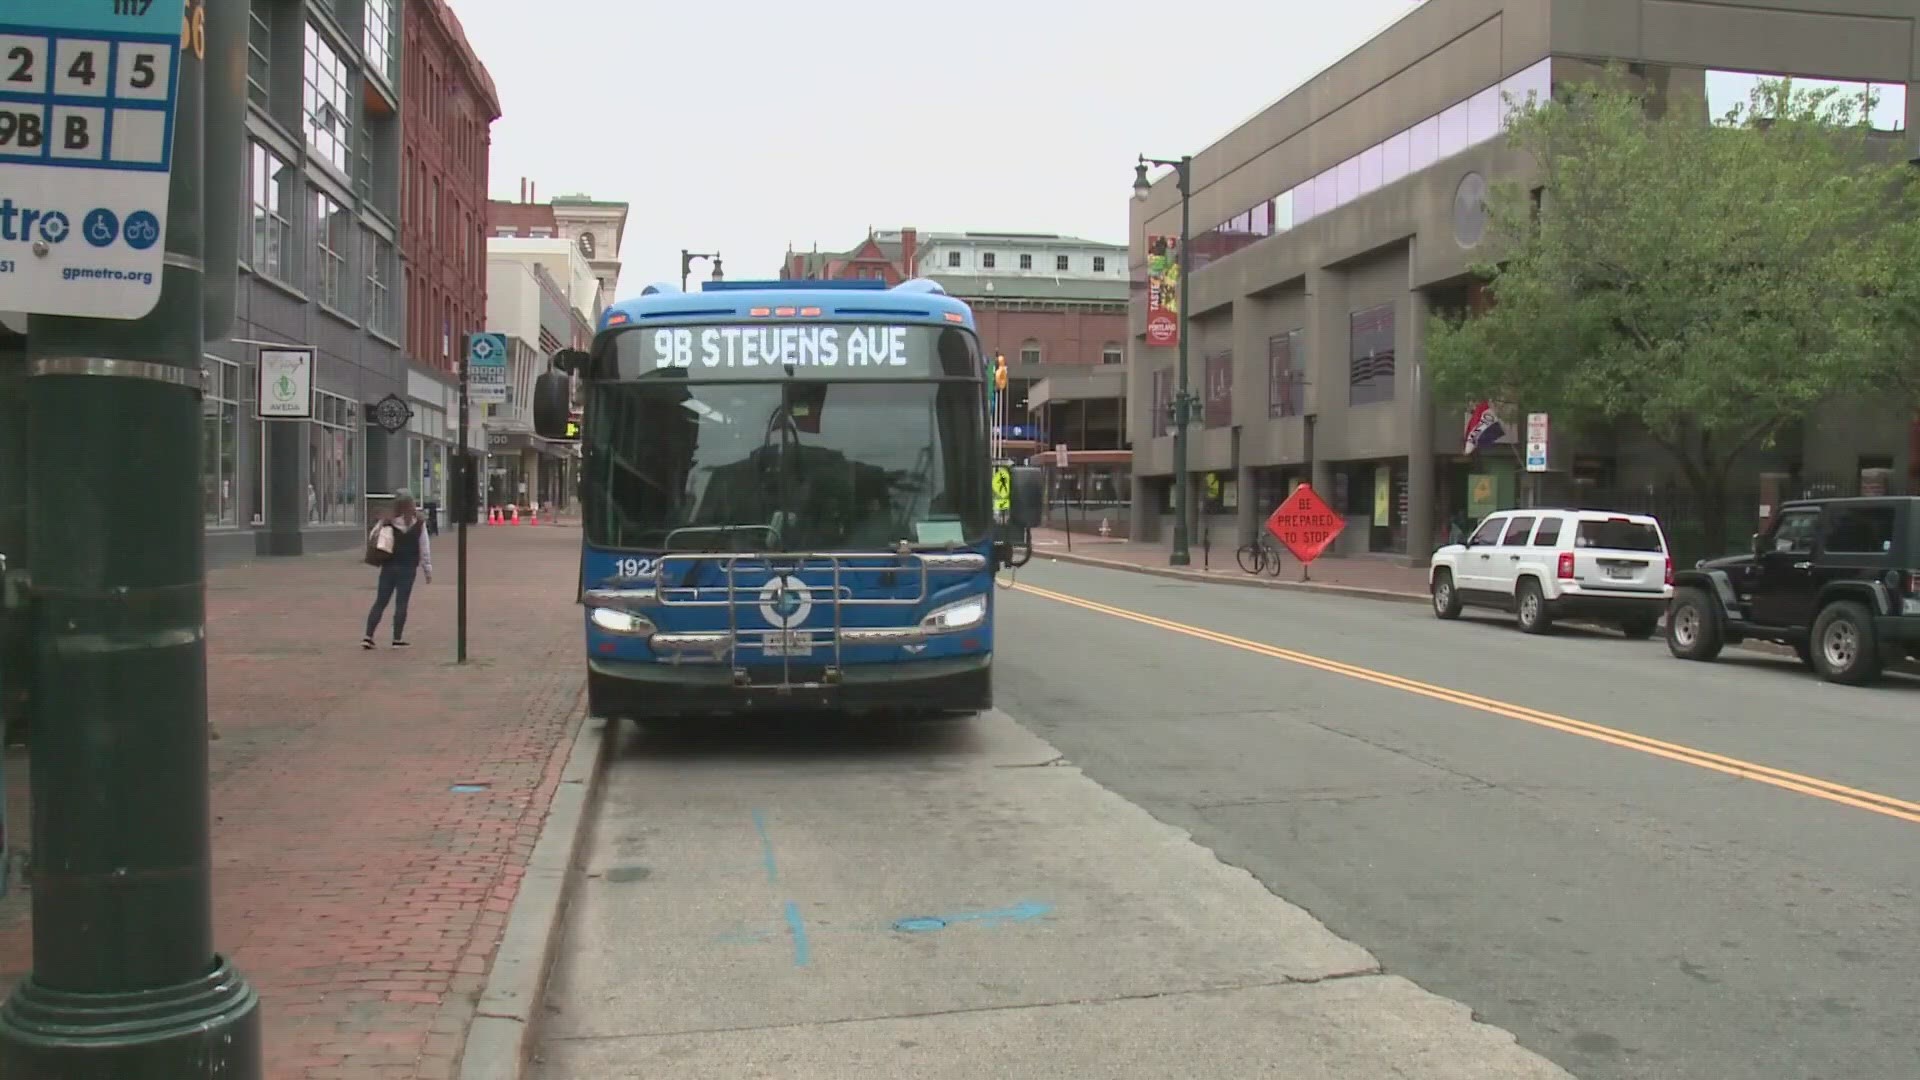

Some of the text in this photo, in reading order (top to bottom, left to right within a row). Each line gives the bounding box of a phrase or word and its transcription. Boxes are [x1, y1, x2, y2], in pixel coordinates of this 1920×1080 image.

[6, 47, 155, 89] 2 4 5
[0, 111, 90, 150] 9B B
[62, 266, 153, 286] gpmetro.org
[654, 326, 907, 368] 9B STEVENS AVE
[1298, 498, 1312, 510] BE
[1277, 514, 1334, 528] PREPARED
[1284, 530, 1330, 544] TO STOP
